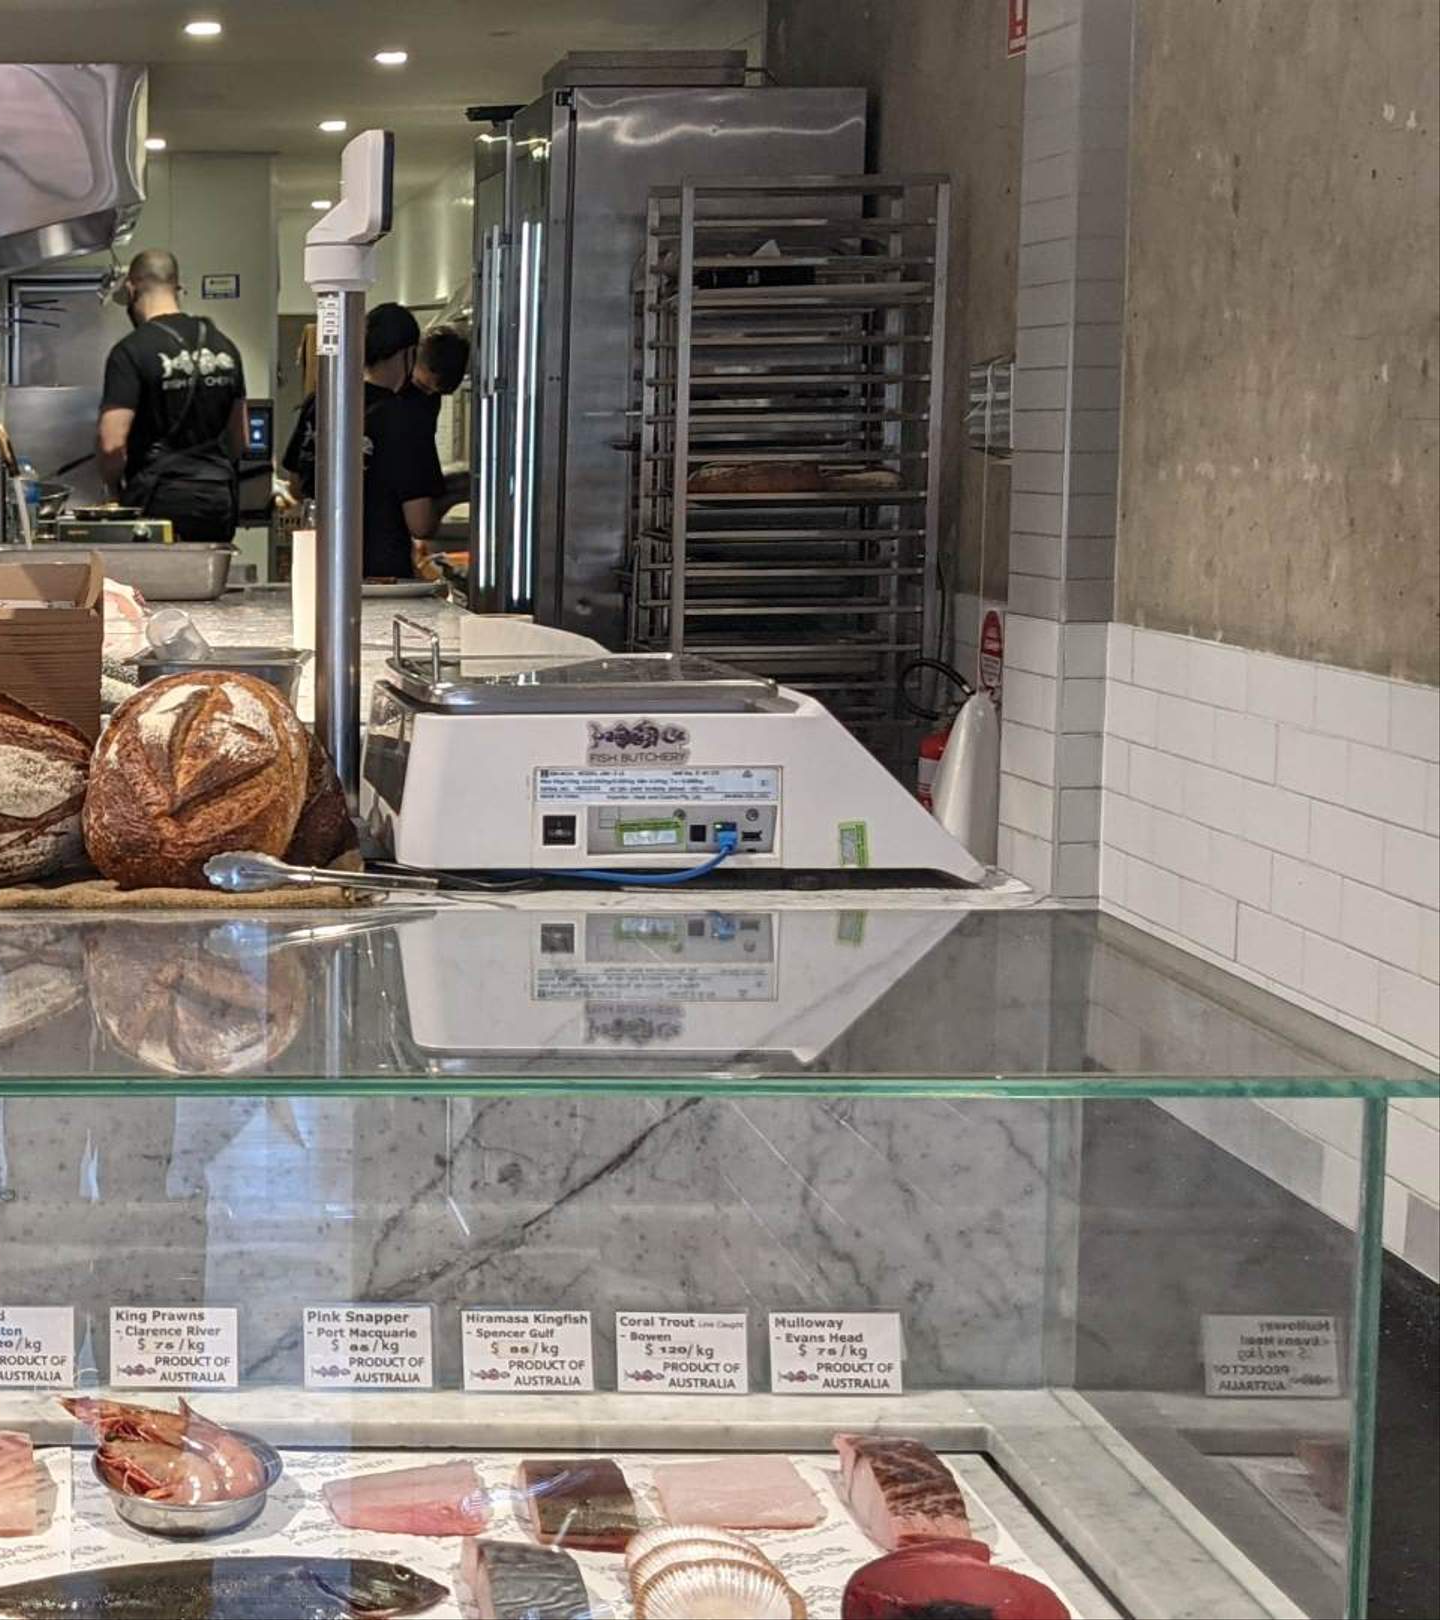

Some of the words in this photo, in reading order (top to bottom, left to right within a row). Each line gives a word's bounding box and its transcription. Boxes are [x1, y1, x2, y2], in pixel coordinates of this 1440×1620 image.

[590, 753, 617, 763] FISH
[620, 752, 686, 762] BUTCHERY
[116, 1311, 147, 1323] King
[152, 1311, 205, 1321] Prawns
[307, 1311, 340, 1323] Pink
[345, 1311, 410, 1325] Snapper
[466, 1313, 529, 1324] Hiramasa
[533, 1313, 588, 1327] Kingfish
[620, 1316, 654, 1327] Coral
[660, 1317, 695, 1328] Trout
[775, 1317, 844, 1330] Mulloway
[125, 1326, 182, 1336] Clarence
[187, 1326, 221, 1336] River
[317, 1328, 345, 1338] Port
[349, 1328, 417, 1341] Macquarie
[476, 1328, 526, 1339] Spencer
[529, 1328, 554, 1338] Gulf
[630, 1332, 672, 1341] Bowen
[785, 1333, 825, 1343] Evans
[829, 1332, 864, 1343] Head
[50, 1356, 67, 1366] OF
[155, 1356, 210, 1366] PRODUCT
[214, 1357, 231, 1367] OF
[348, 1357, 405, 1367] PRODUCT
[408, 1357, 425, 1367] OF
[508, 1360, 565, 1370] PRODUCT
[568, 1360, 585, 1370] OF
[663, 1362, 720, 1373] PRODUCT
[723, 1362, 740, 1373] OF
[816, 1362, 874, 1373] PRODUCT
[877, 1363, 894, 1373] OF
[160, 1372, 226, 1382] AUSTRALIA
[354, 1373, 421, 1383] AUSTRALIA
[514, 1375, 581, 1386] AUSTRALIA
[668, 1378, 736, 1388] AUSTRALIA
[822, 1378, 890, 1389] AUSTRALIA
